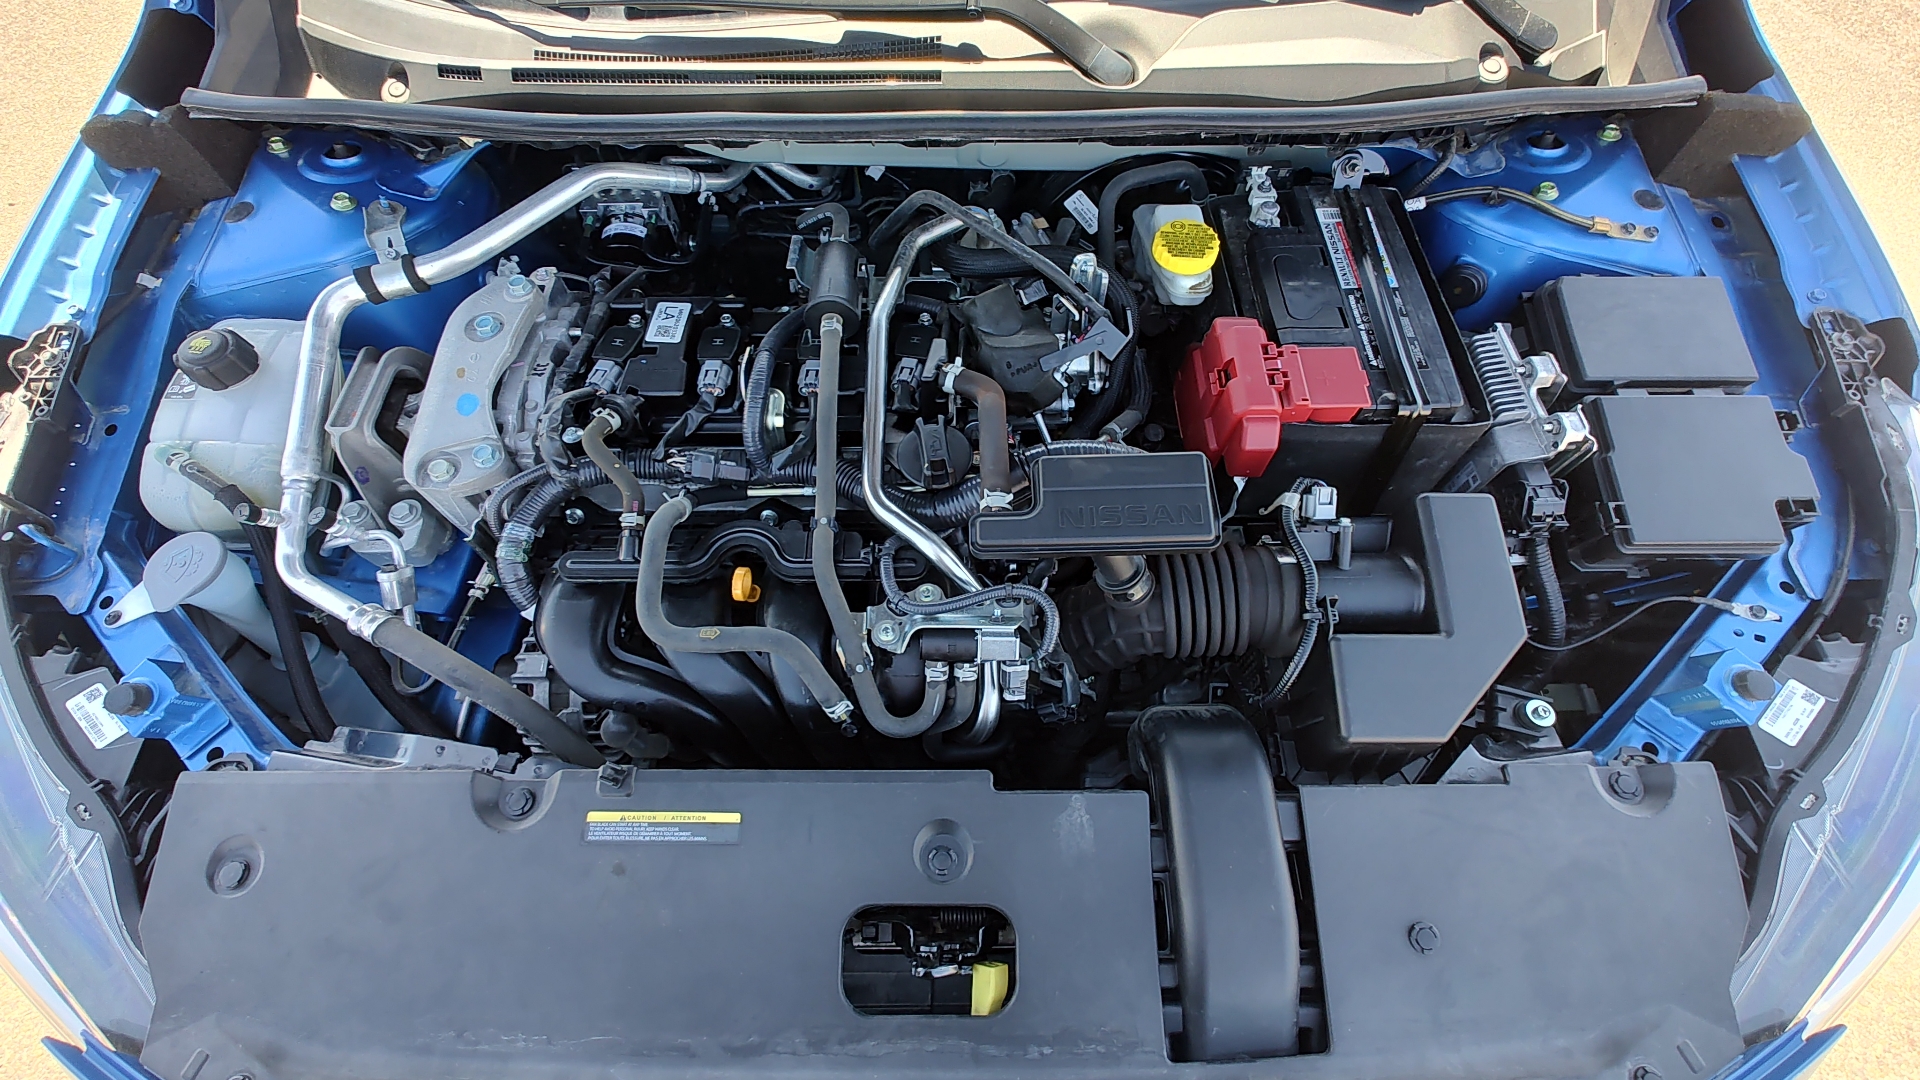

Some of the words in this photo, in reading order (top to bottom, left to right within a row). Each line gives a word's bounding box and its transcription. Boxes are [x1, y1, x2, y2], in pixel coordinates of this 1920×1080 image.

[1324, 223, 1341, 255] NISSAN
[1335, 256, 1351, 287] RENAULT
[661, 306, 679, 321] LA
[1059, 503, 1205, 528] NISSAN
